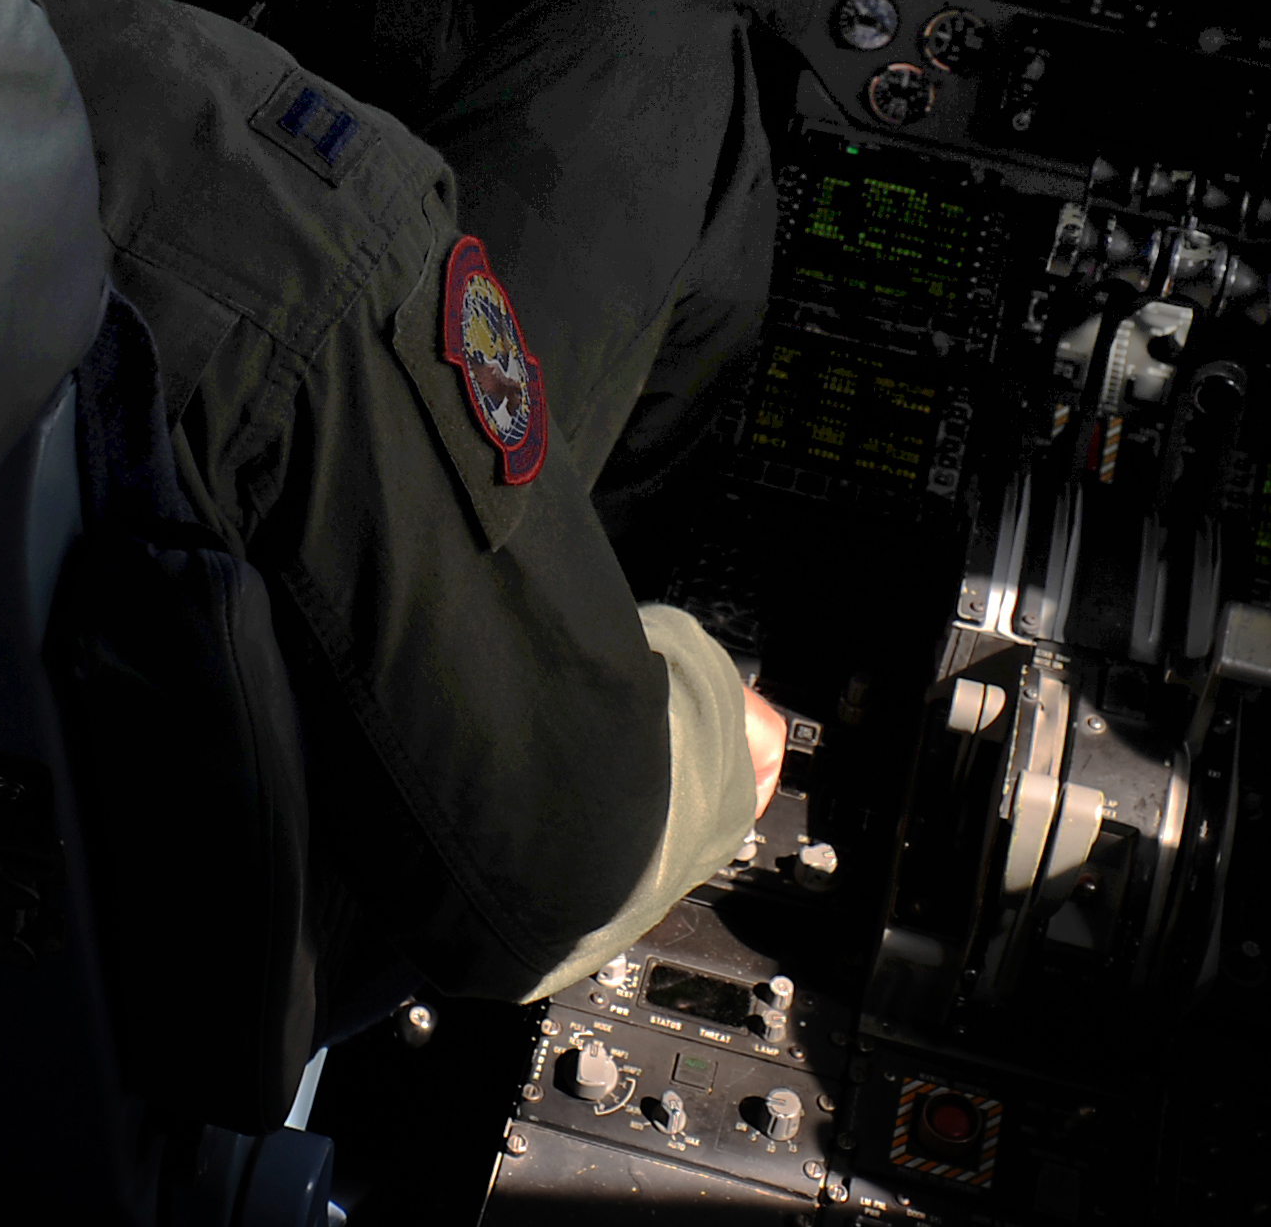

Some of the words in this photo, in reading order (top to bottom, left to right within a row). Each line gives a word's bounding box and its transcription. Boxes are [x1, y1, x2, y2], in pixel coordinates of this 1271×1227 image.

[649, 1015, 683, 1031] STATUS
[699, 1028, 732, 1044] THREAT
[754, 1043, 780, 1056] LAMP
[533, 1039, 550, 1080] RADAR
[667, 1140, 687, 1152] AUTO
